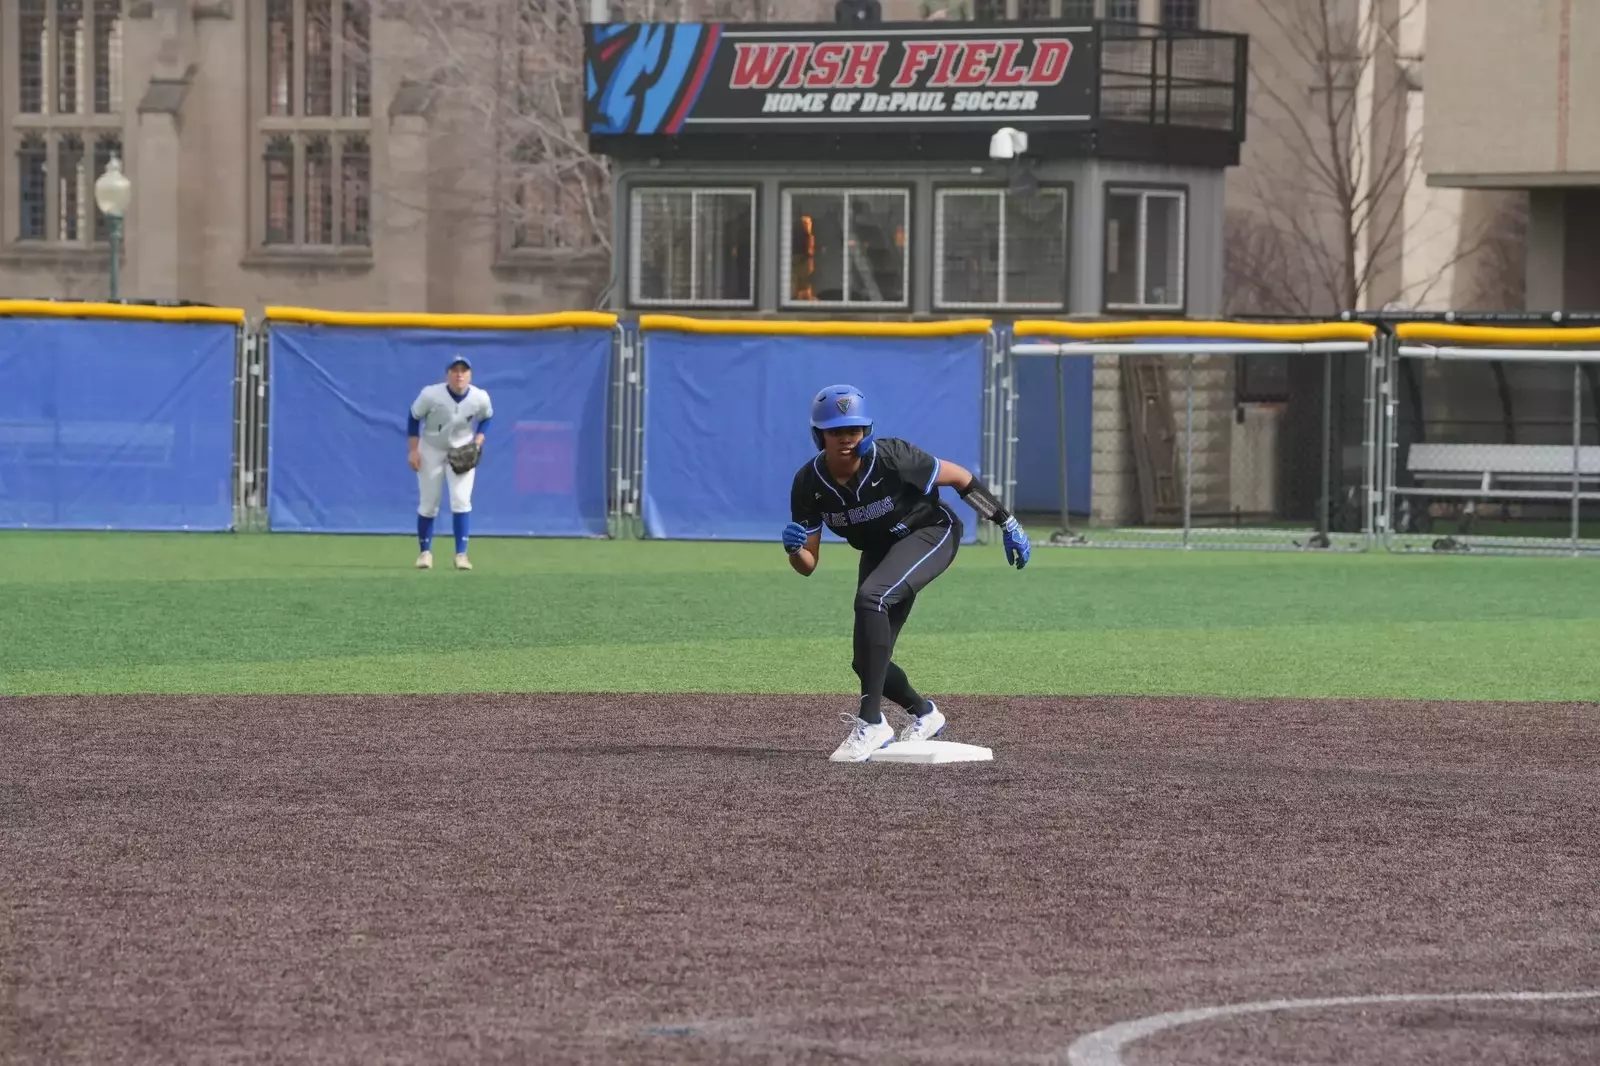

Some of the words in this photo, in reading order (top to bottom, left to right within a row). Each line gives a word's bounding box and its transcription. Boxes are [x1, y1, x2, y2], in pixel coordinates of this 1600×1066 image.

[729, 41, 890, 89] WISH
[890, 38, 1074, 88] FIELD
[762, 93, 828, 112] HOME
[830, 93, 861, 112] OF
[951, 91, 1039, 111] SOCCER
